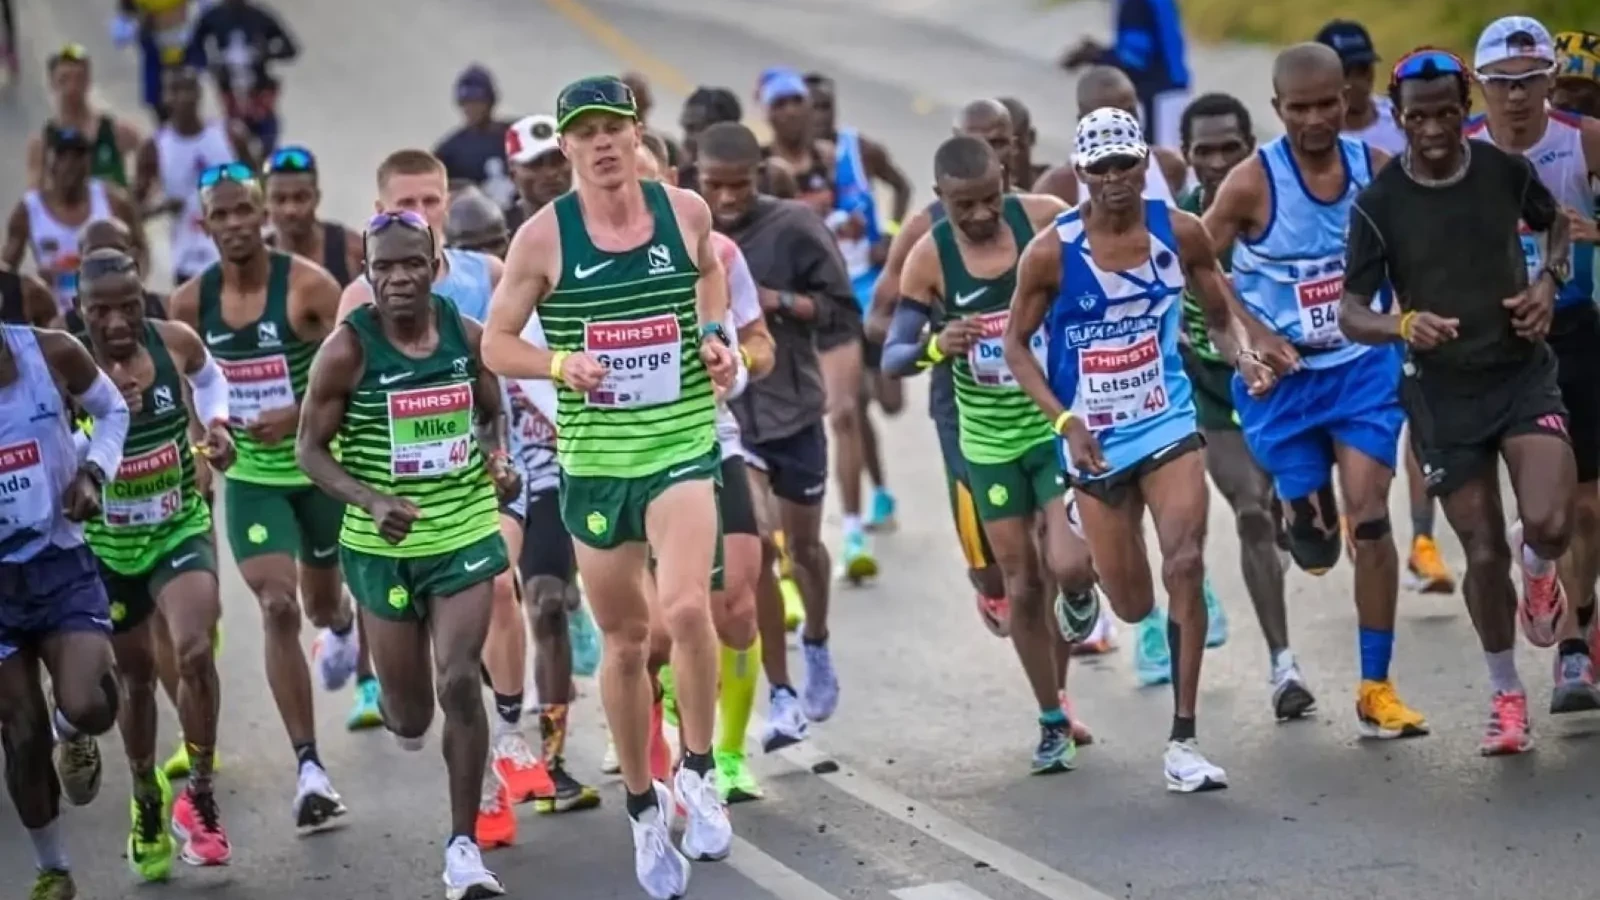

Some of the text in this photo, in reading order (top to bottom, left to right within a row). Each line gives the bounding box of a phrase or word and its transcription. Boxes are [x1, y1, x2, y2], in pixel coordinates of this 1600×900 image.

[593, 323, 673, 342] THIRSTI
[596, 351, 671, 371] George
[1083, 346, 1155, 367] THIRSTI
[1088, 363, 1159, 393] Letsatsi
[395, 391, 467, 411] THIRSTI
[1143, 385, 1165, 411] 40
[414, 419, 456, 438] Mike
[120, 450, 173, 474] HIRSTI
[449, 439, 468, 465] 40
[114, 474, 176, 497] Claude
